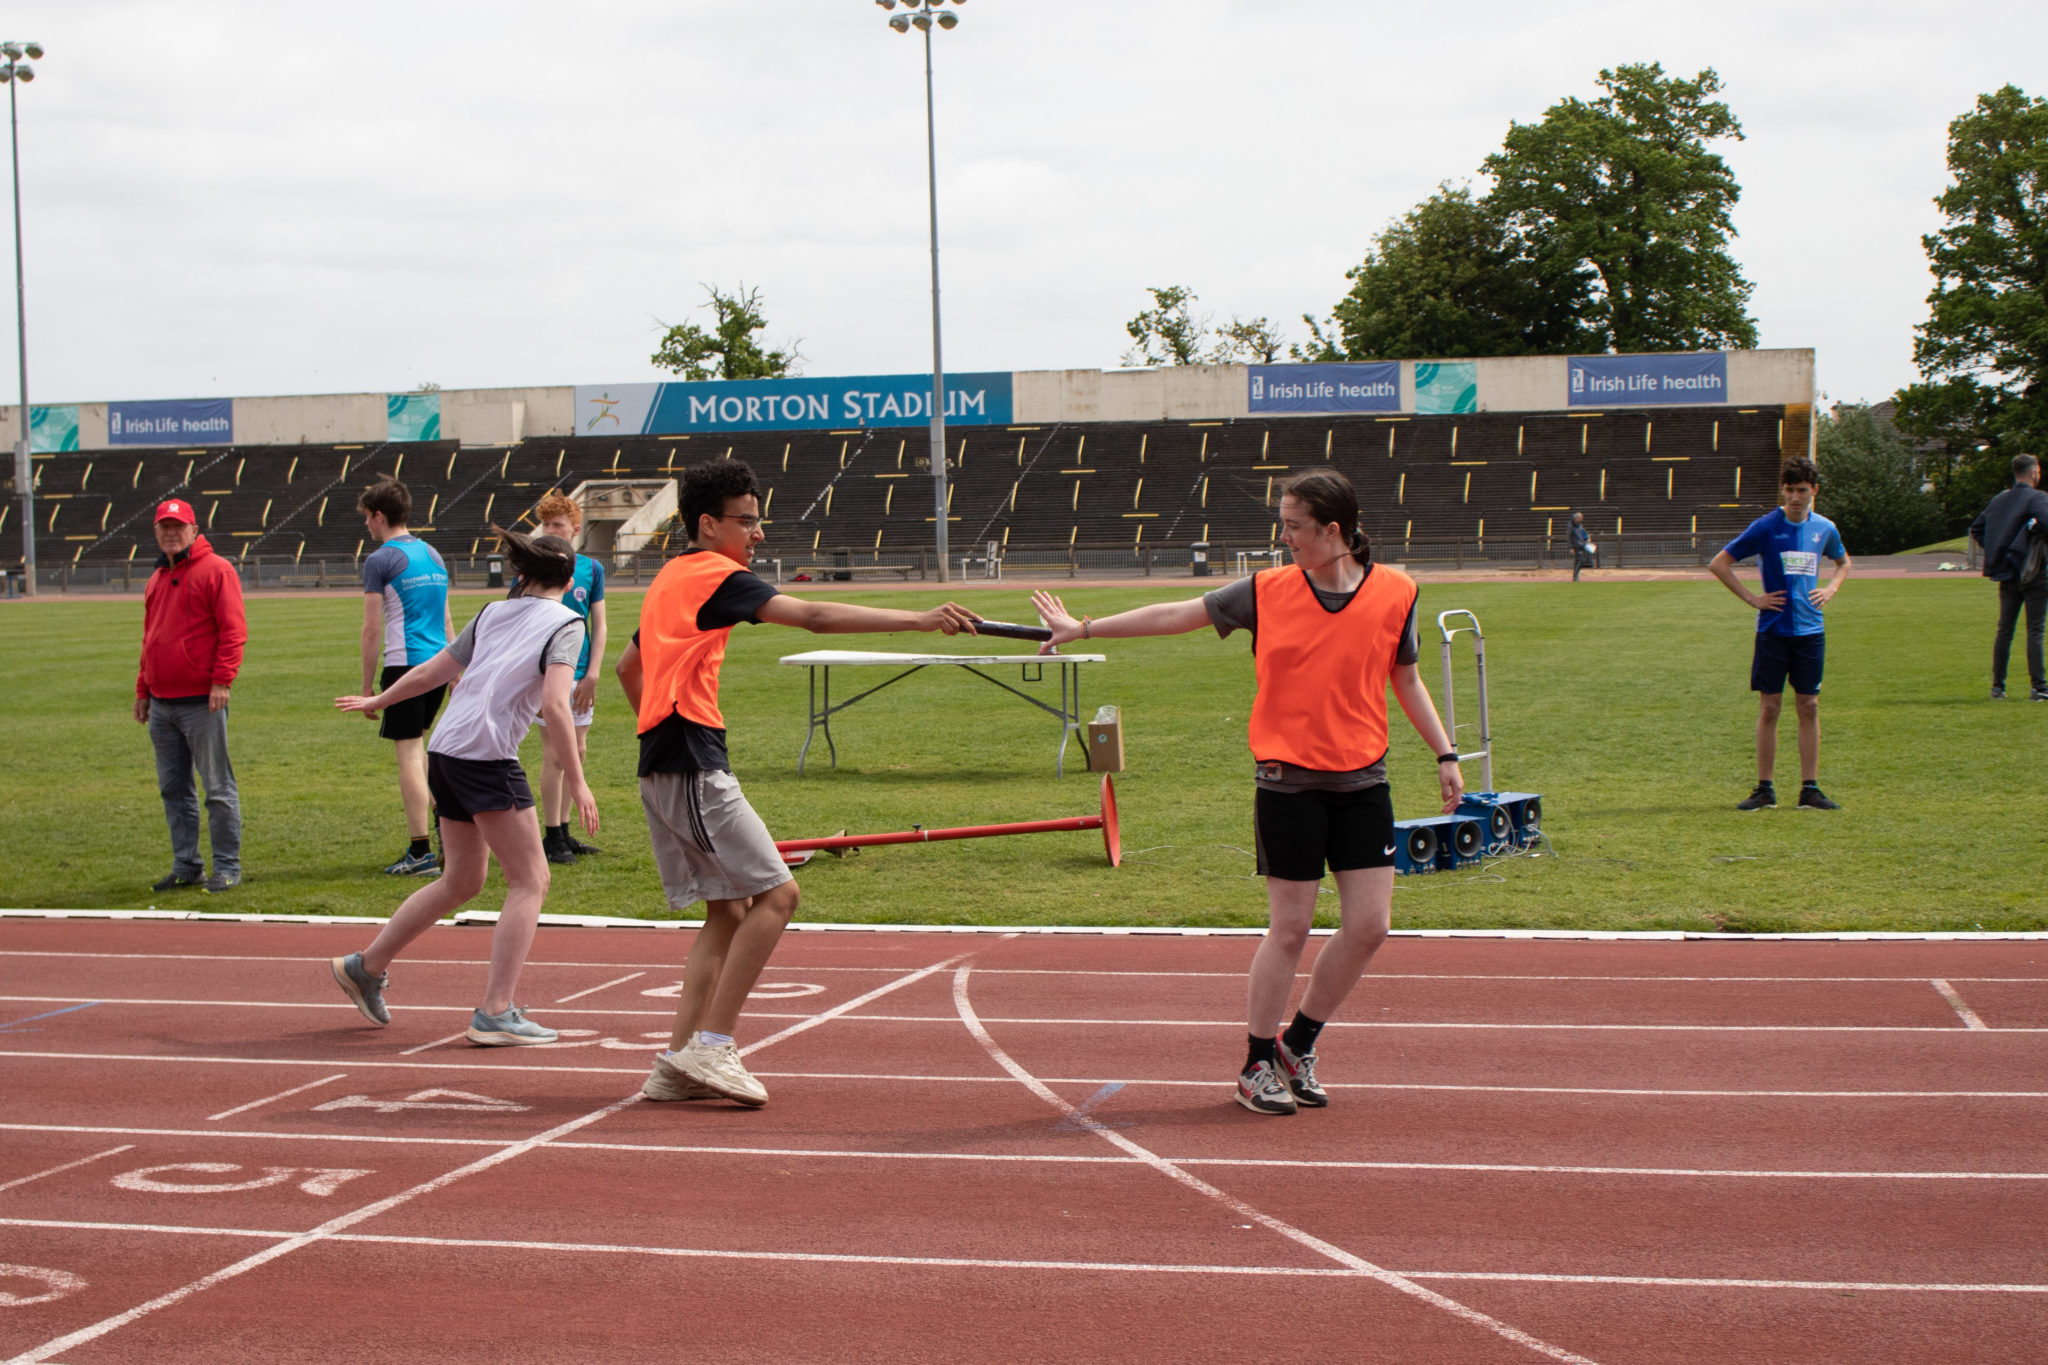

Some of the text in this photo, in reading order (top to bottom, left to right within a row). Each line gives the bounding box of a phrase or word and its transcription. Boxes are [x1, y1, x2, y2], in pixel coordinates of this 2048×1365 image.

[1269, 382, 1395, 398] Irish Life health
[1590, 374, 1721, 391] Irish Life health
[689, 394, 829, 423] MORTON
[125, 417, 229, 434] Irish Life health
[310, 1088, 532, 1112] 4
[110, 1162, 377, 1196] 5
